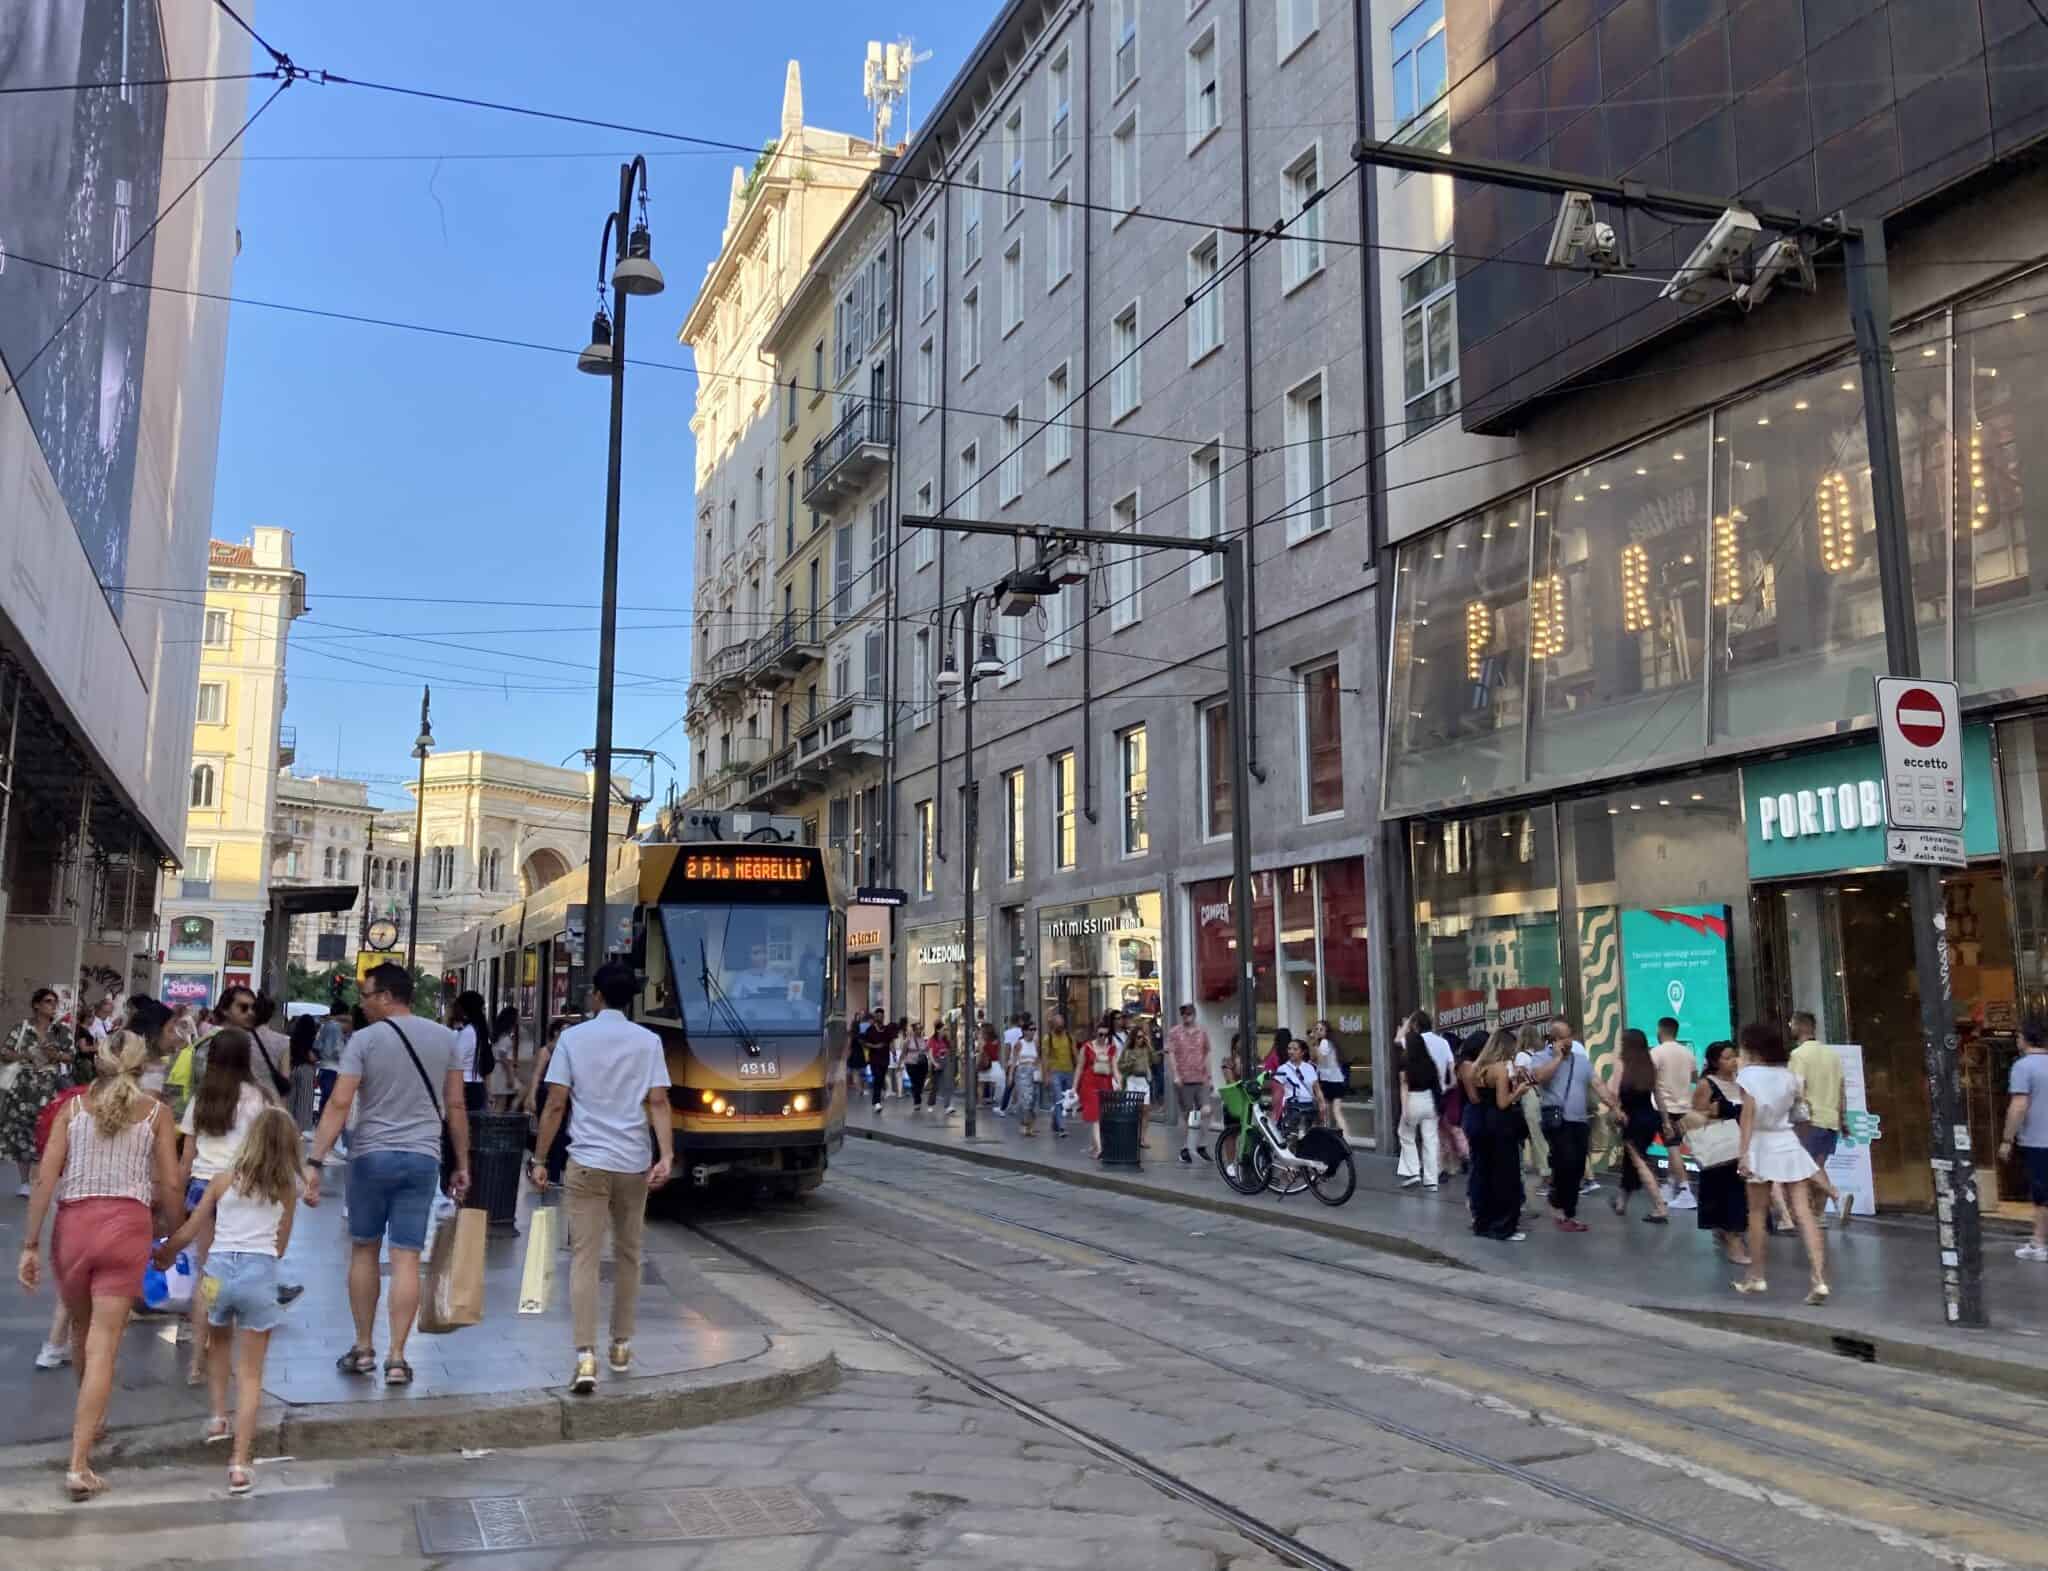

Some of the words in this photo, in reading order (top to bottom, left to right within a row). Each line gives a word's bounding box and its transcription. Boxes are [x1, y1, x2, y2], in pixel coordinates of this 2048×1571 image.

[1904, 757, 1949, 770] eccetto
[1759, 779, 1888, 842] PORTOB
[687, 856, 697, 879] 2
[1201, 903, 1230, 926] CAMPER
[1048, 915, 1118, 938] intimissimi
[919, 944, 966, 963] CALZEDONIA
[167, 980, 207, 996] Barbie
[1500, 1006, 1526, 1025] SUPER
[1526, 1000, 1550, 1019] SALDI
